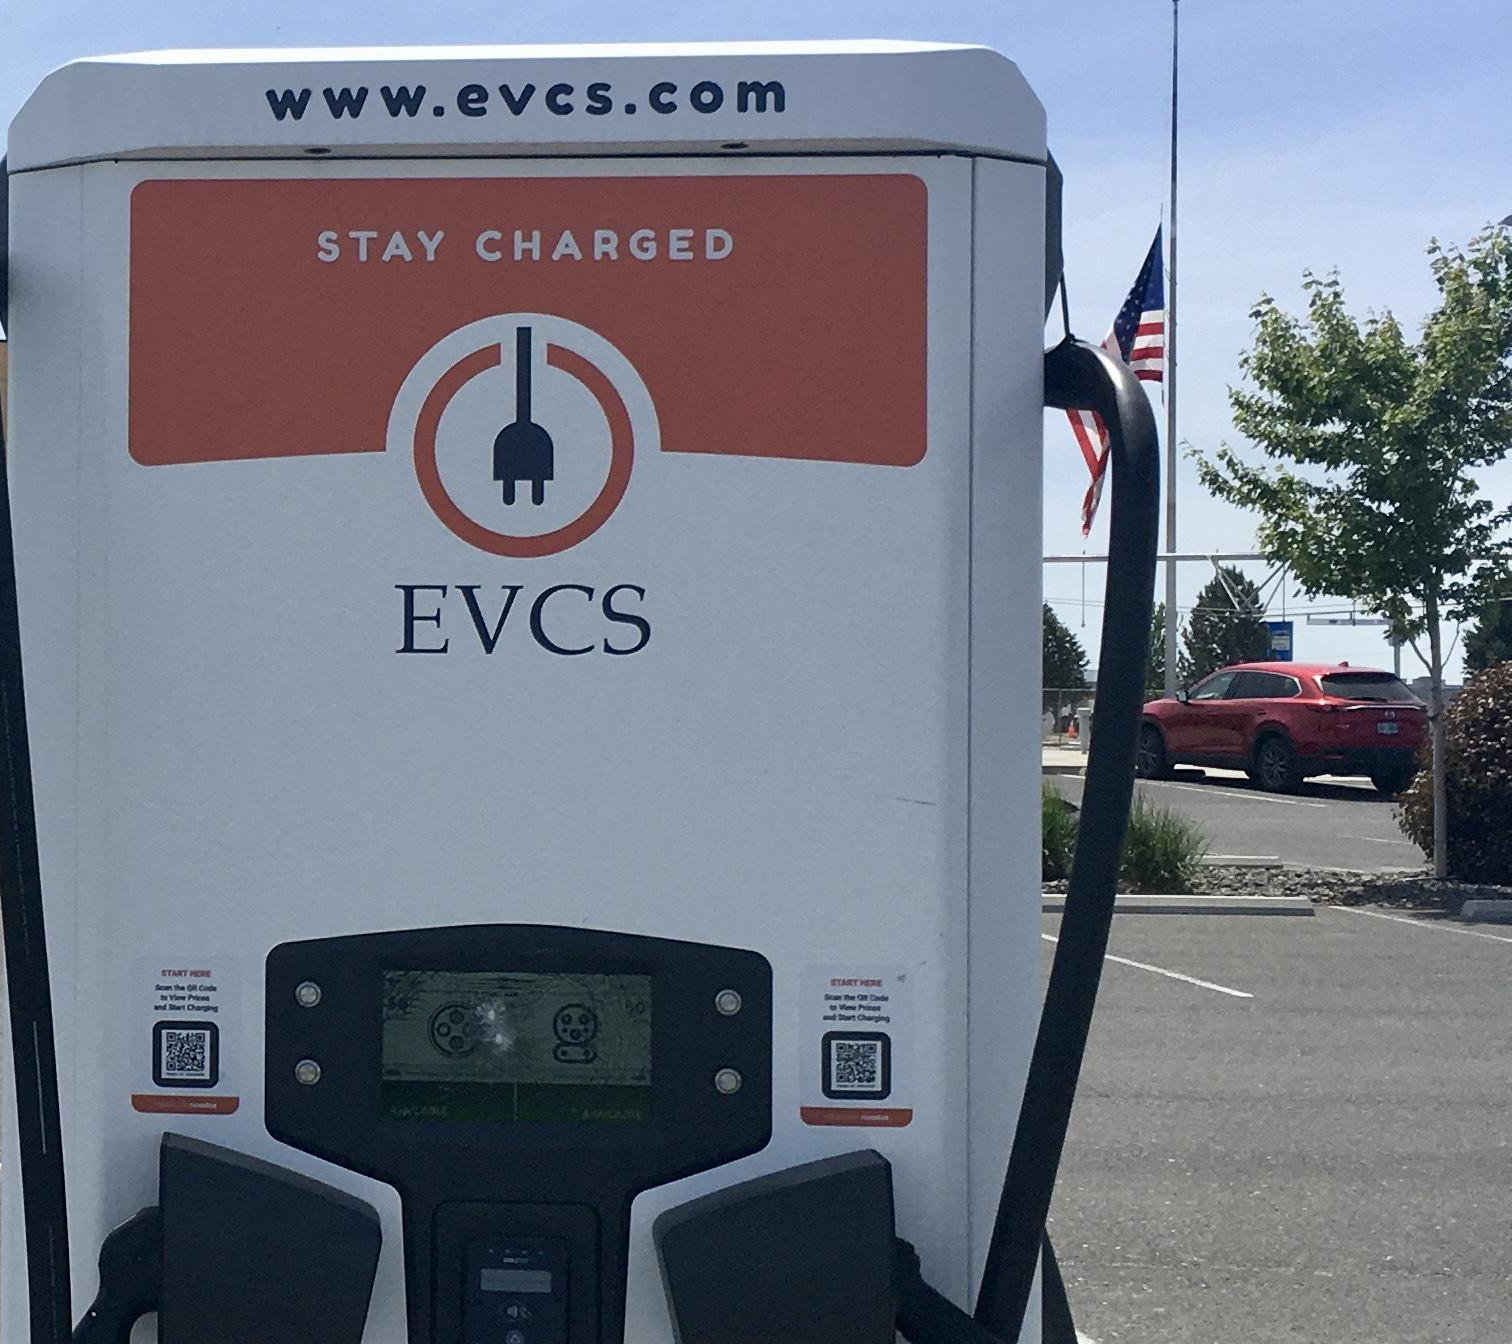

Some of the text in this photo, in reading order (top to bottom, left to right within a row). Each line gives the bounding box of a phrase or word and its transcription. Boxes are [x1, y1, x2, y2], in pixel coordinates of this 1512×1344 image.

[266, 81, 785, 121] www.evcs.com
[318, 229, 733, 261] STAY CHARGED
[395, 584, 650, 655] EVCS
